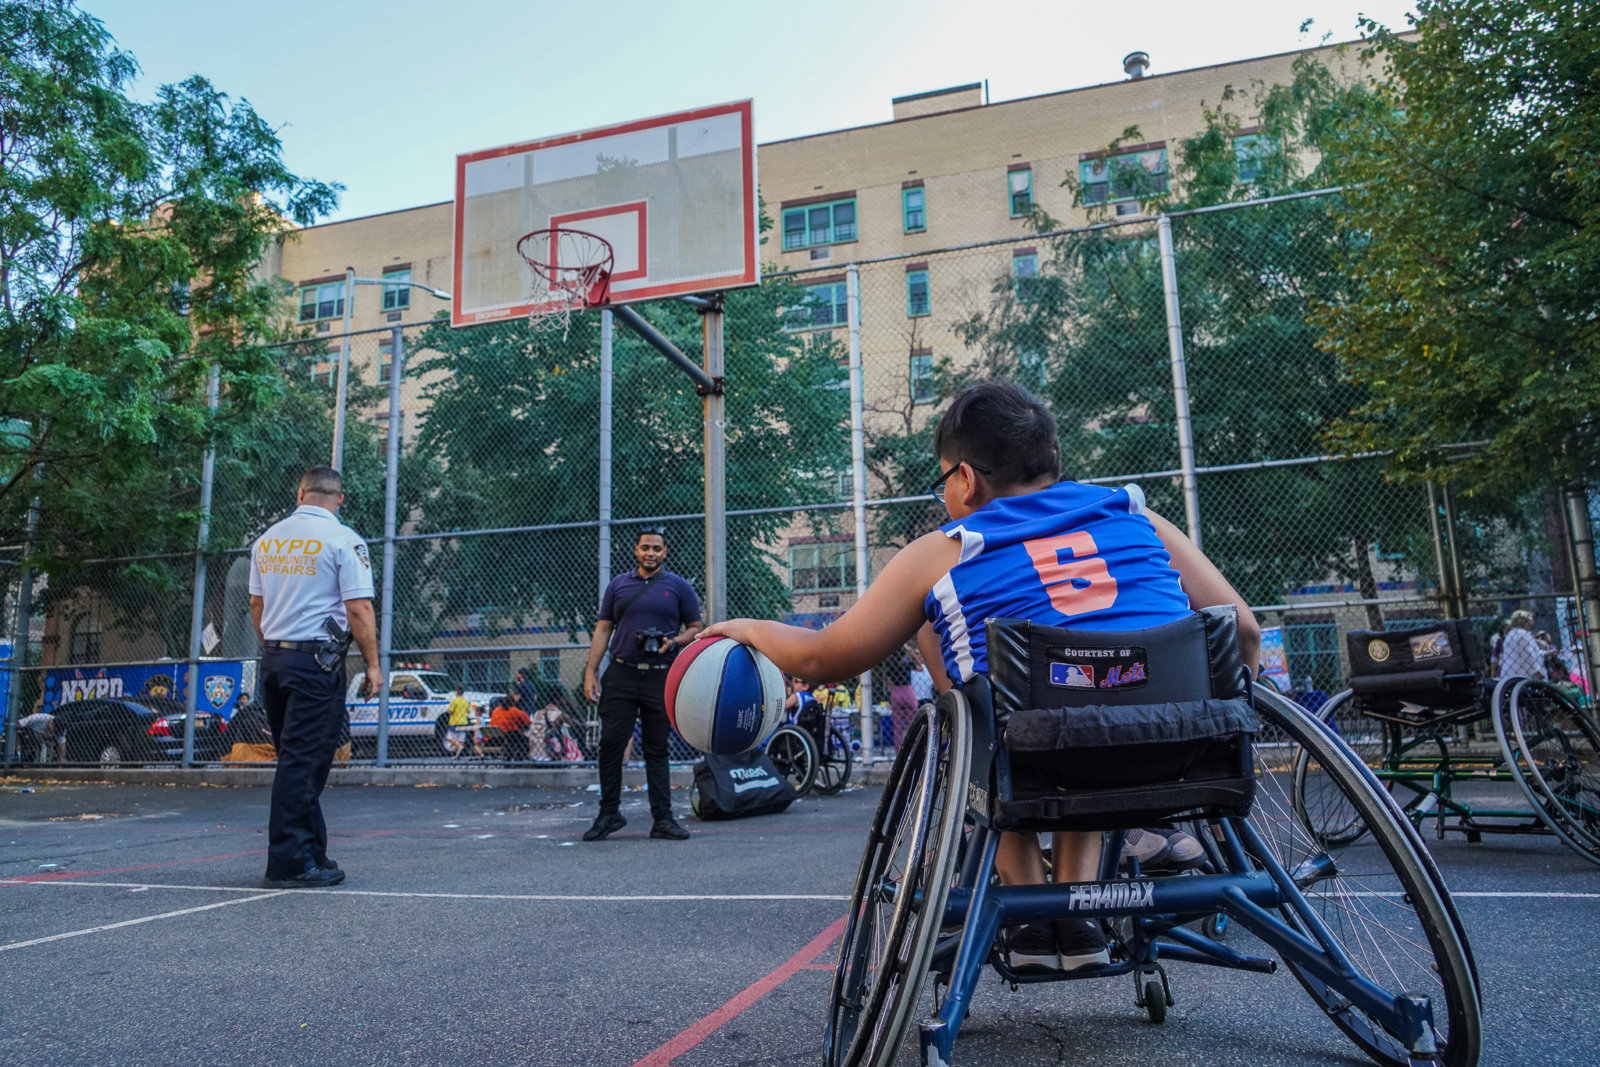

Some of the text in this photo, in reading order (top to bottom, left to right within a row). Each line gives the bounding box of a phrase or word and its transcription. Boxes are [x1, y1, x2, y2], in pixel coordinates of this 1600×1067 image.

[258, 539, 322, 555] NYPD
[257, 554, 318, 566] COMMUNITY
[259, 564, 317, 576] AFFAIRS
[1022, 531, 1119, 616] 5
[1064, 647, 1131, 657] COURTESY OF
[1100, 662, 1147, 688] Mets
[60, 678, 123, 706] NYPD
[387, 706, 419, 719] NYPD
